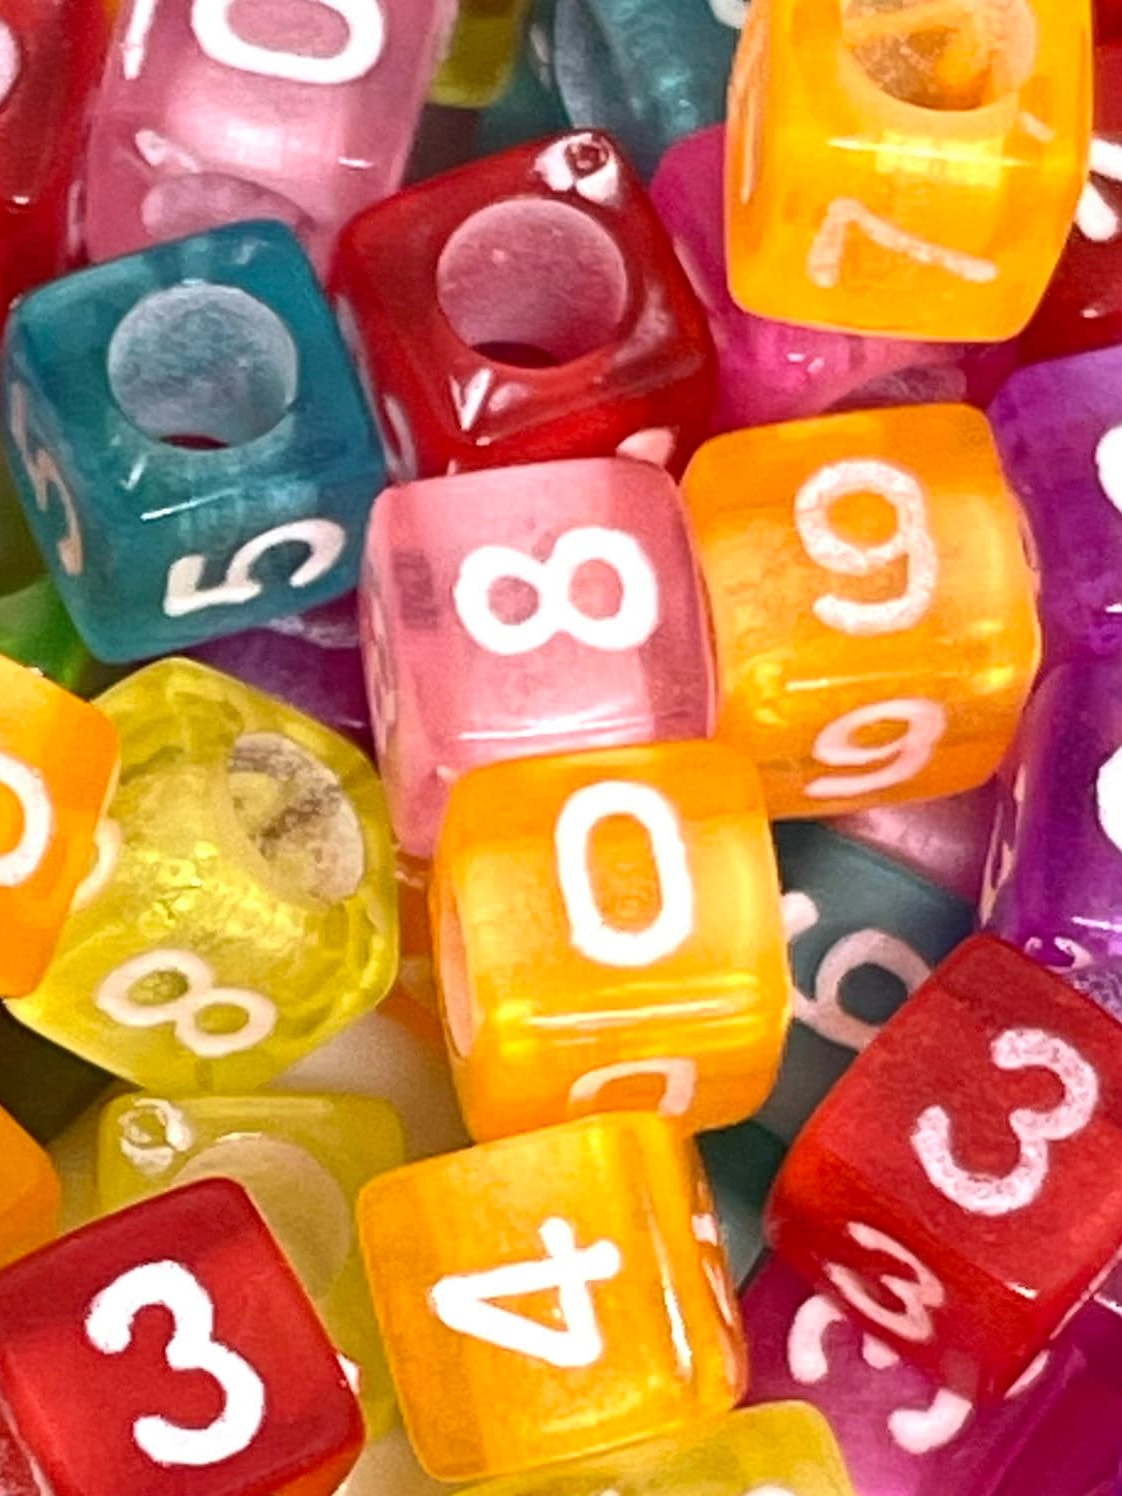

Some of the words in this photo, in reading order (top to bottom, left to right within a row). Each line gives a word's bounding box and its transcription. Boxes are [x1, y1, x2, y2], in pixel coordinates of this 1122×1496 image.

[807, 199, 1002, 287] 7
[162, 518, 346, 617] 5
[454, 526, 658, 654] 8
[795, 458, 938, 636] 9
[554, 781, 694, 967] 0
[95, 948, 277, 1058] 8
[911, 1027, 1100, 1216] 3
[430, 1217, 621, 1368] 4
[826, 1221, 946, 1342] 3
[85, 1259, 266, 1466] 3
